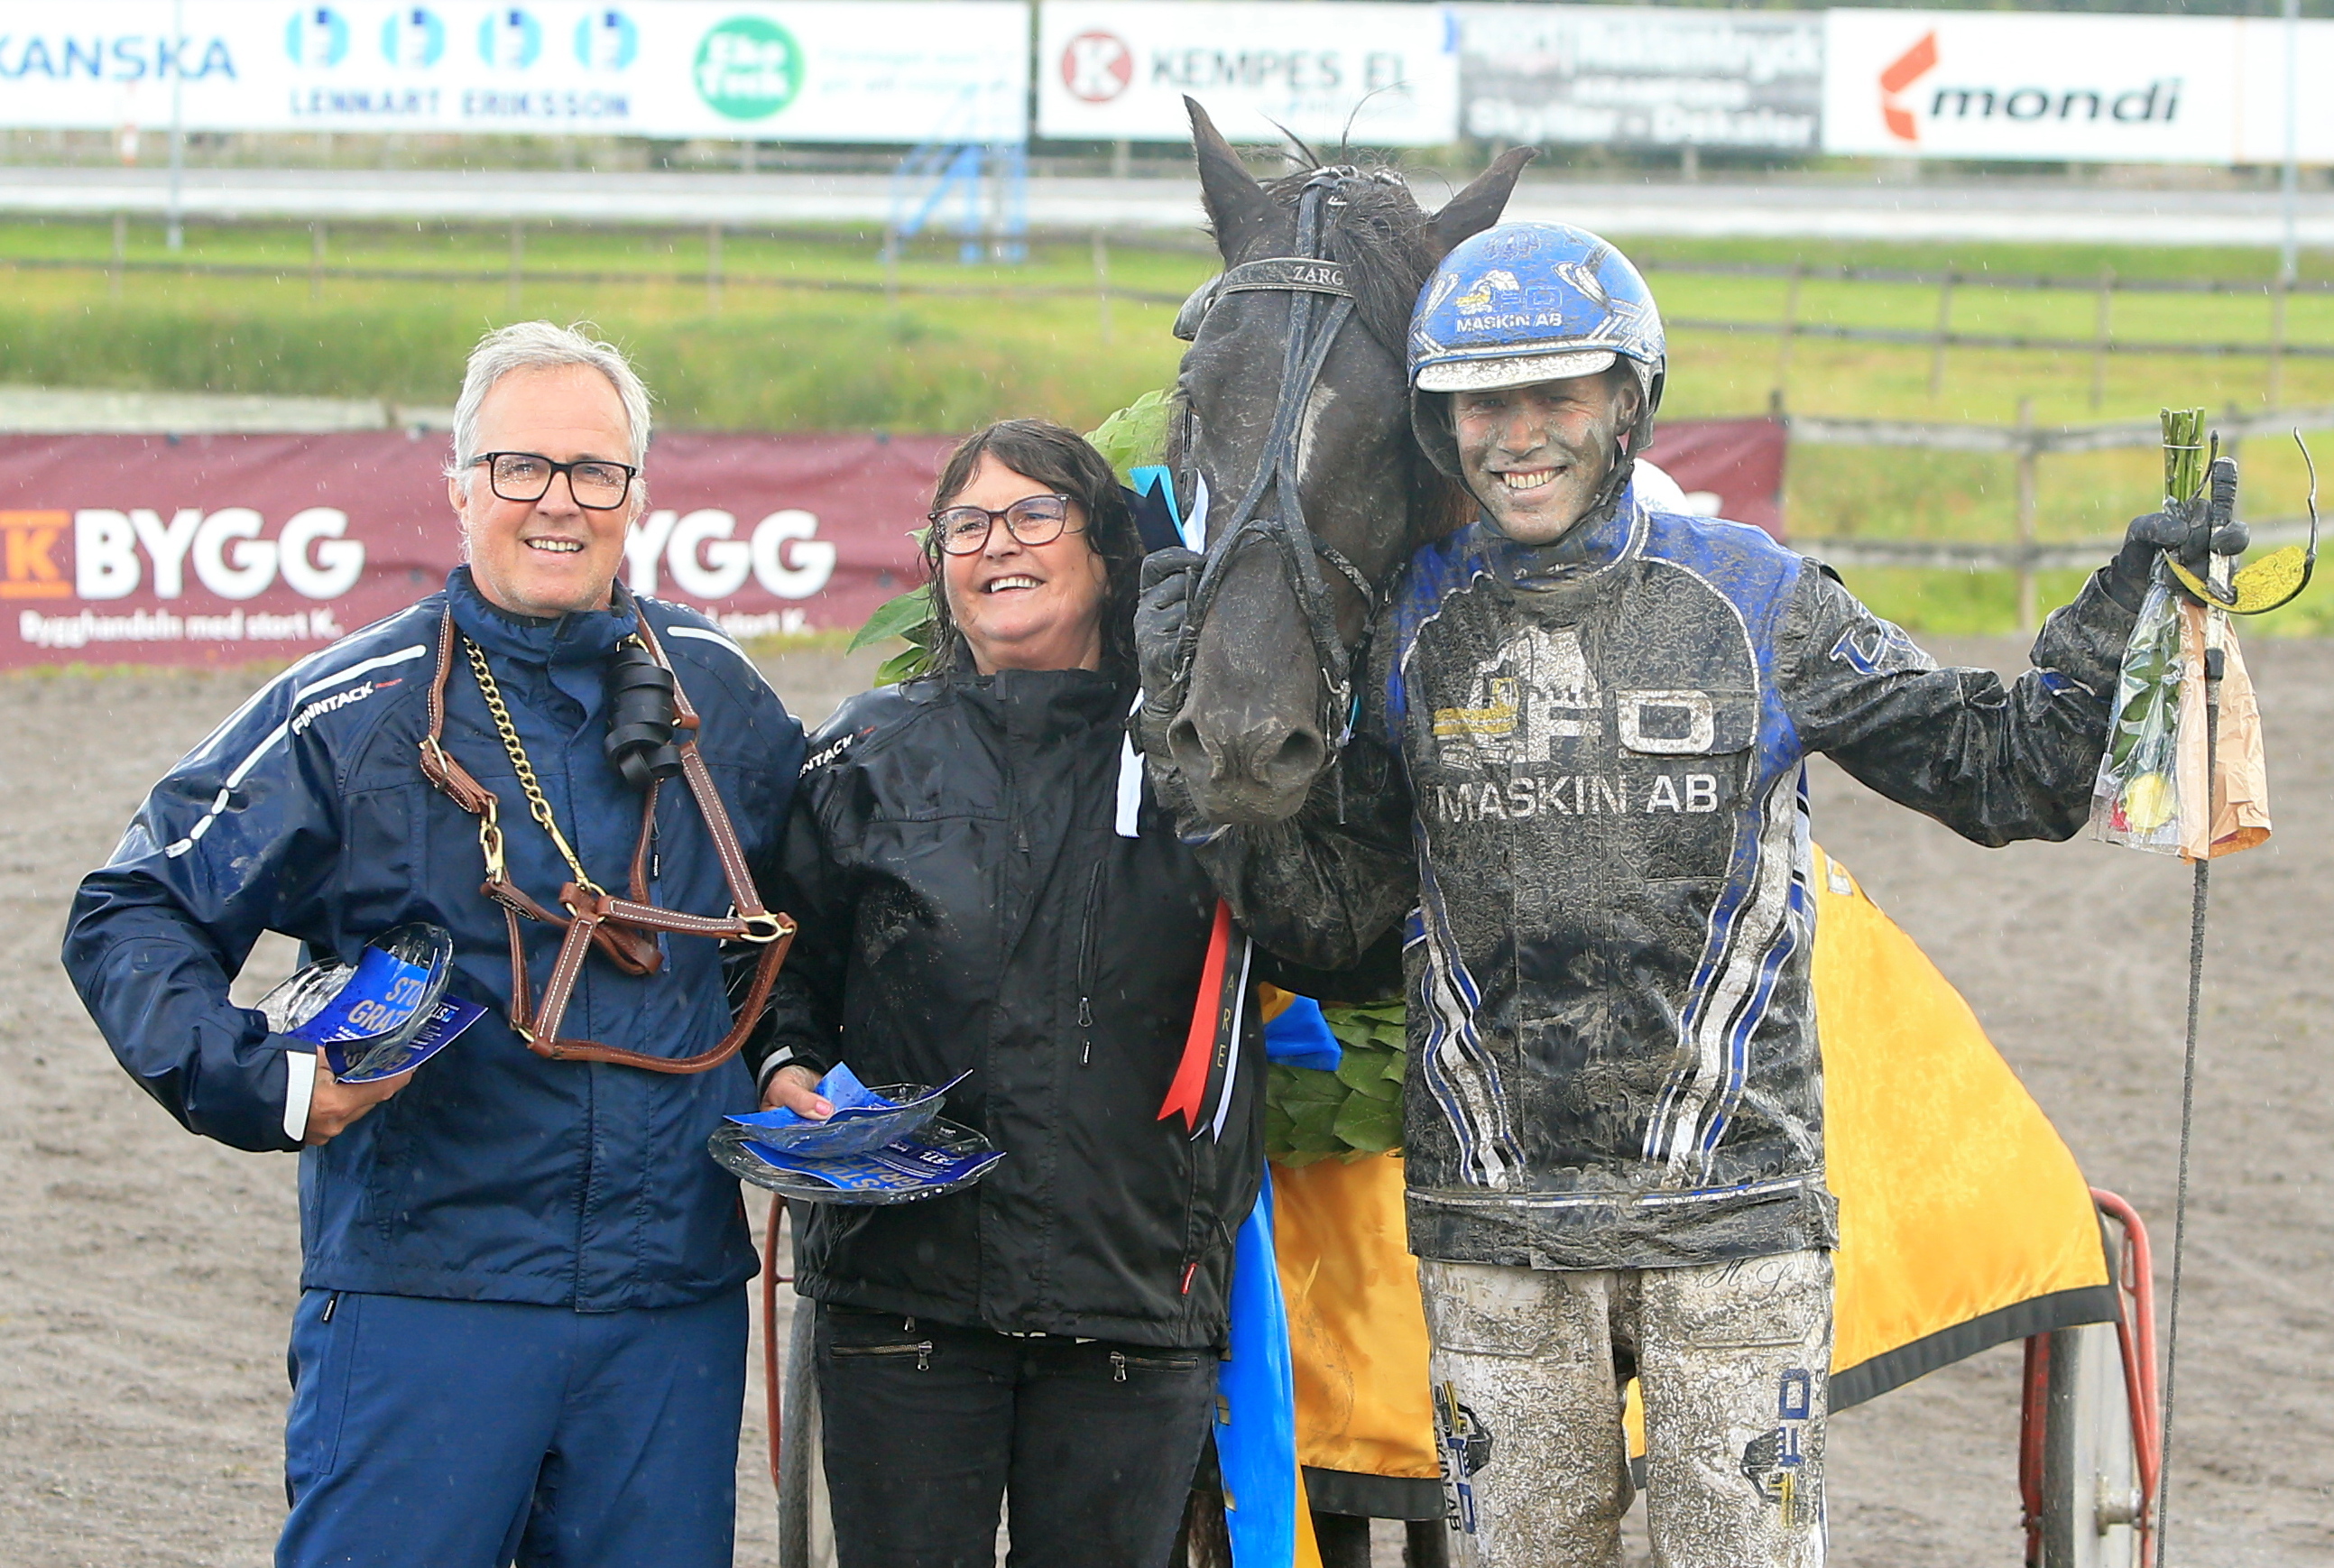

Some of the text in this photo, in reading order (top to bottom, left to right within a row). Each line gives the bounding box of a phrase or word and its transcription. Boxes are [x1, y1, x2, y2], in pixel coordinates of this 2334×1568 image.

[1152, 49, 1409, 90] KEMPES EL
[289, 88, 632, 118] LENNART ERIKSSON
[1929, 78, 2182, 124] mondi
[1456, 312, 1564, 333] MASKIN AB
[74, 507, 365, 601] BYGG
[624, 509, 837, 600] YGG
[291, 681, 374, 735] FINNTACK
[799, 733, 853, 779] NTACK
[1437, 773, 1719, 823] MASKIN AB
